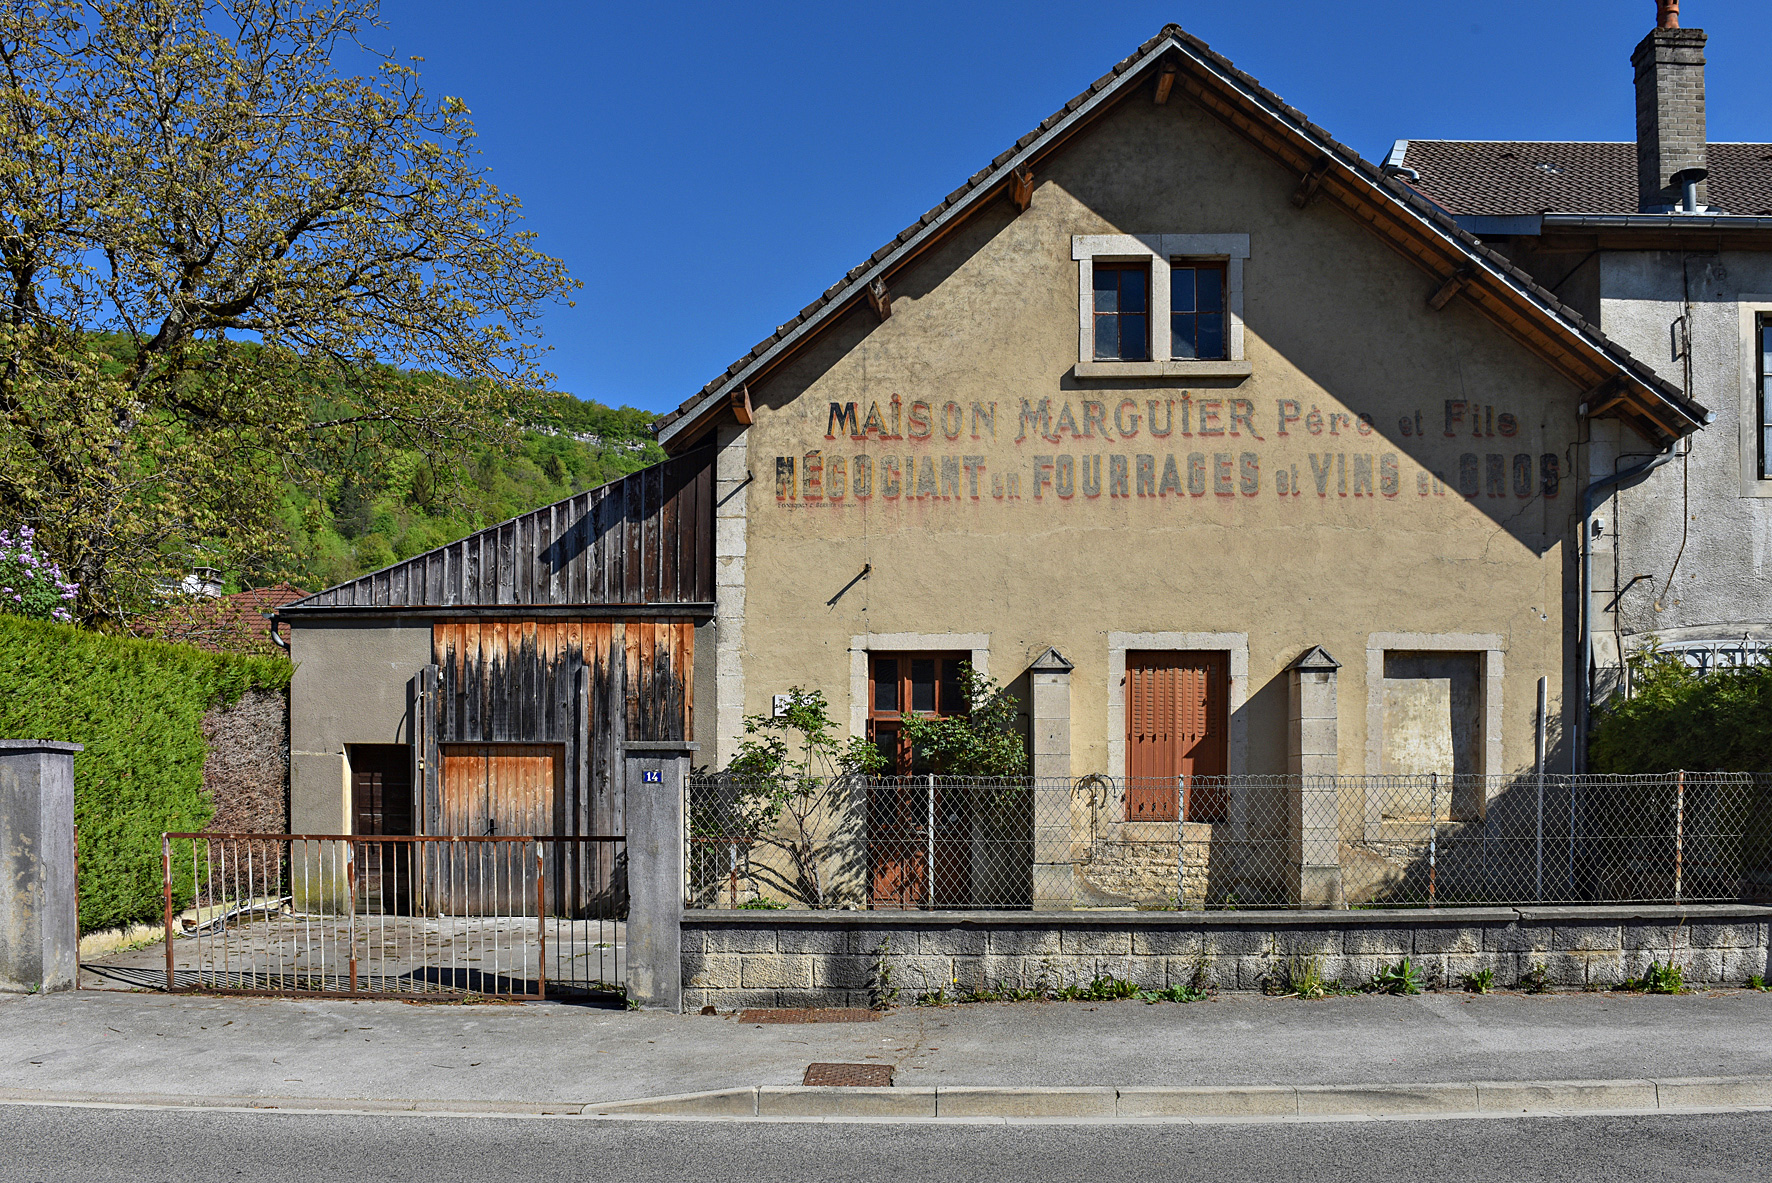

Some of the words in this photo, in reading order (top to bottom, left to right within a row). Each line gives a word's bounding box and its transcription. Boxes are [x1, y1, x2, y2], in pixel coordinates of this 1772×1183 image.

[824, 393, 998, 441] MAISON
[1014, 390, 1266, 444] MARGUIER
[1276, 399, 1375, 437] Père
[1398, 409, 1424, 437] et
[1443, 399, 1520, 438] Fils
[775, 450, 987, 501] NÉGOCIANT
[990, 472, 1022, 500] en
[1032, 452, 1261, 501] FOURRAGES
[1275, 463, 1301, 497] et
[1307, 453, 1400, 499] VINS
[1416, 470, 1446, 497] en
[1458, 452, 1561, 499] GROS
[646, 771, 659, 782] 14
